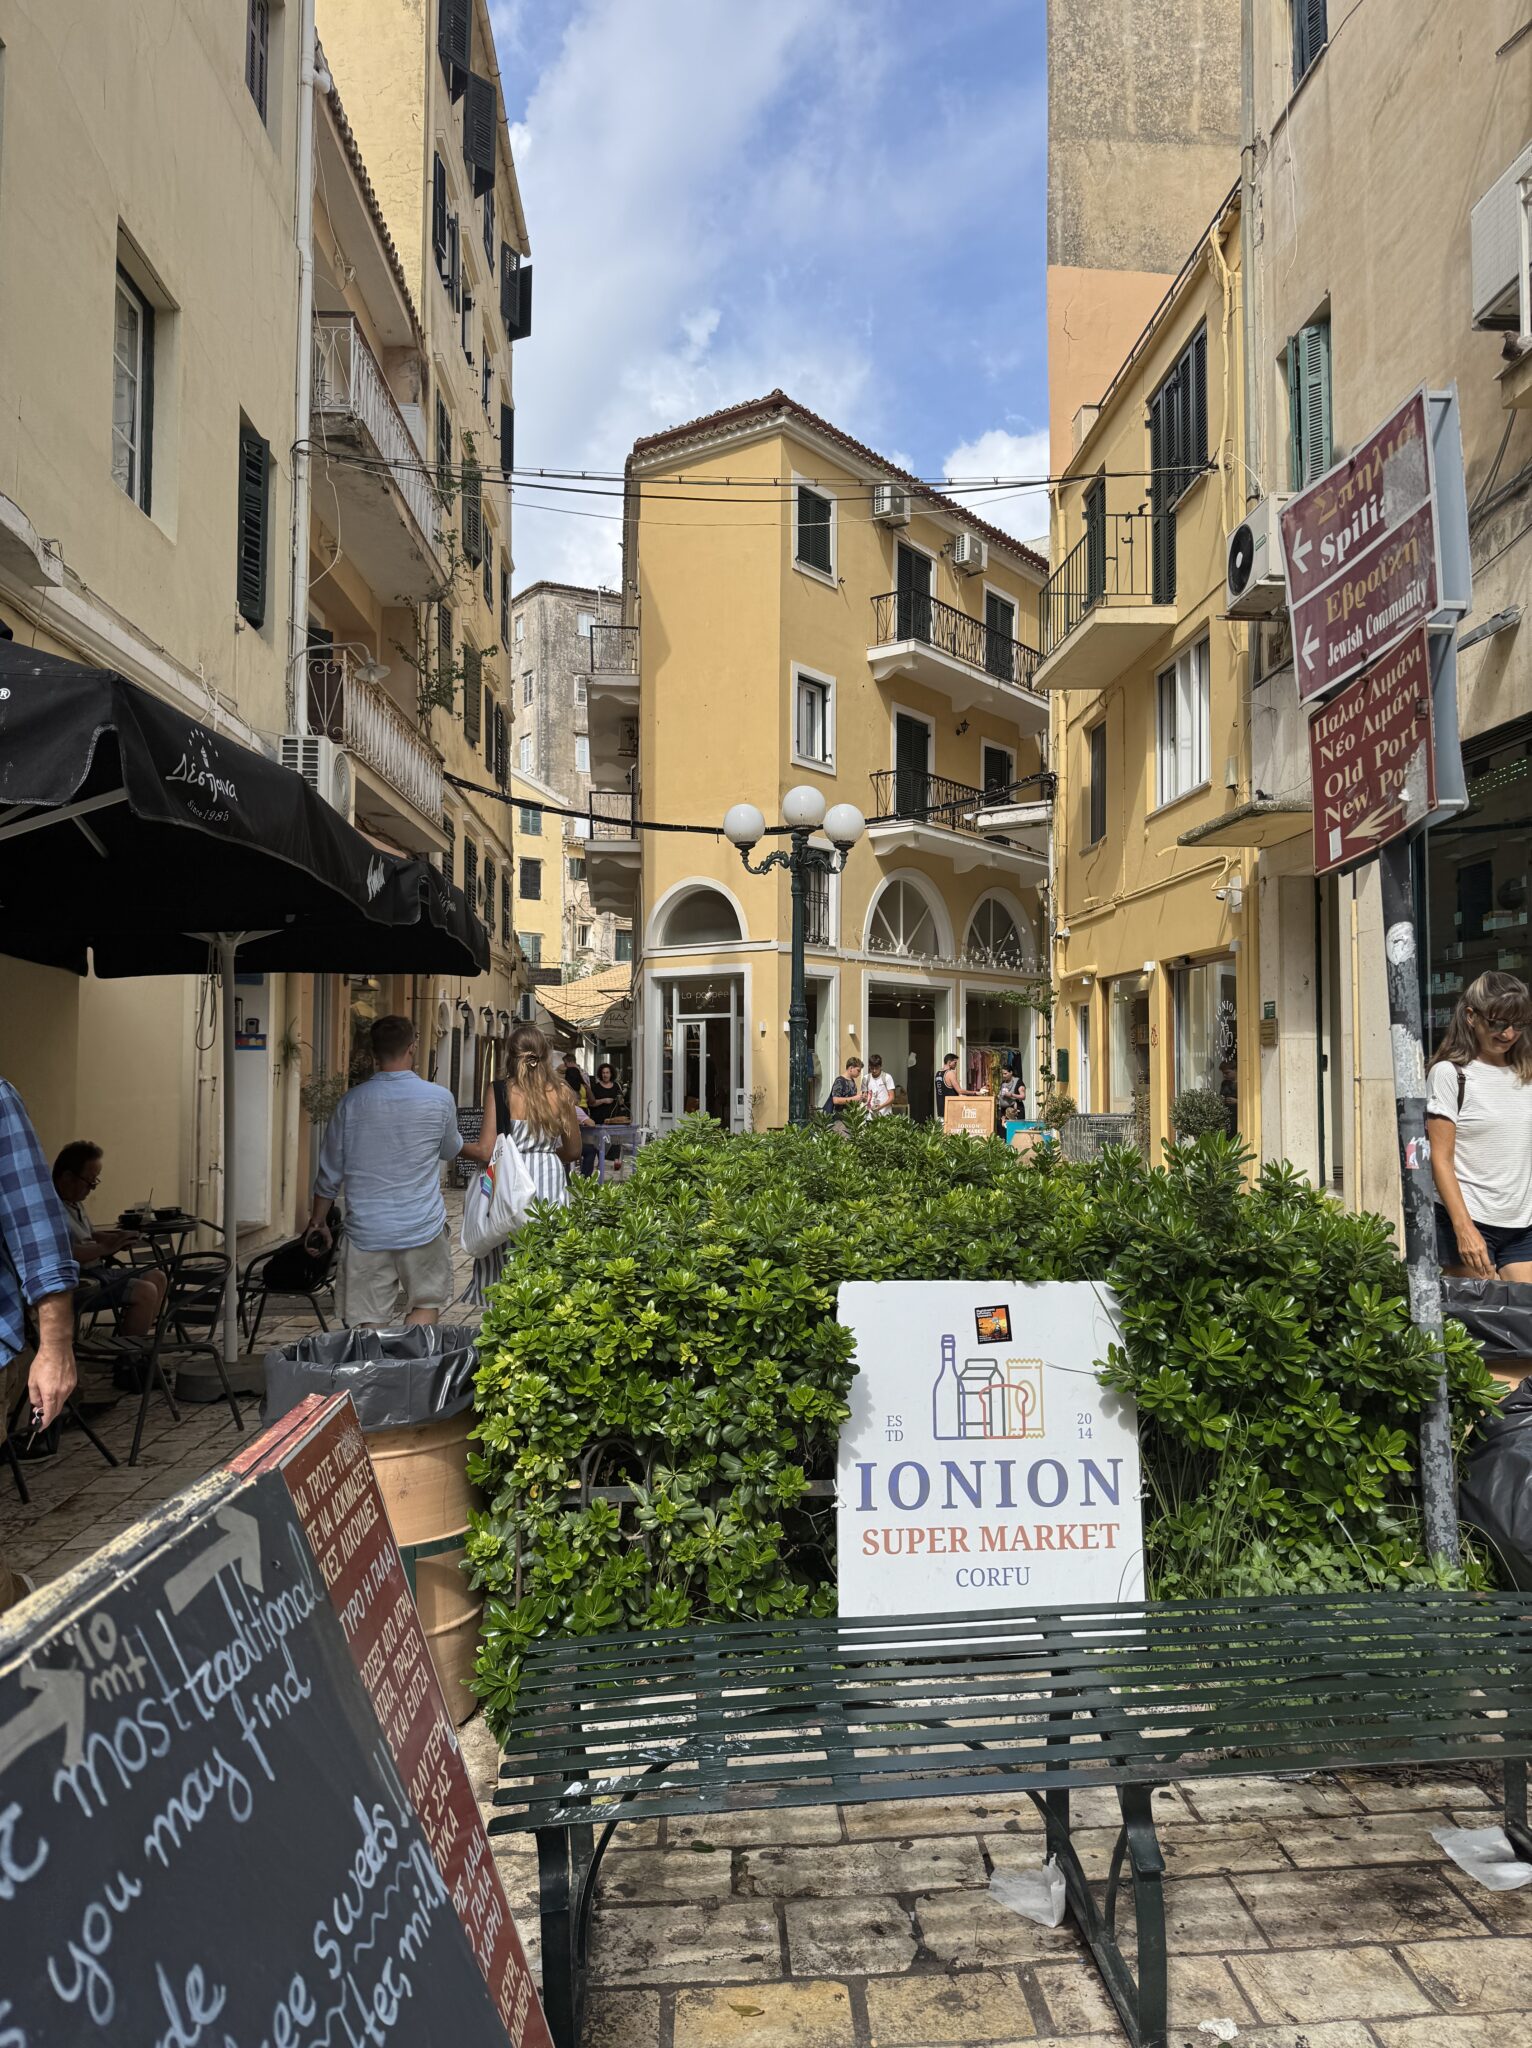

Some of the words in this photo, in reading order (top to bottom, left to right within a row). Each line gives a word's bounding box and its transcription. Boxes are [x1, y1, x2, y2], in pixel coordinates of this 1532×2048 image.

[1328, 624, 1363, 667] Jewish
[1366, 579, 1427, 640] Community
[1314, 690, 1364, 744] Παλιό
[1369, 645, 1422, 705] Λιμάνι
[1320, 733, 1355, 768] Νέο
[1361, 679, 1420, 743] Λιμάνι
[1324, 757, 1364, 798] Old
[1374, 717, 1419, 771] Port
[203, 809, 230, 822] 1985
[1324, 792, 1370, 831] New
[885, 1430, 904, 1442] TD
[886, 1415, 903, 1427] ES
[1076, 1412, 1092, 1425] 20
[1077, 1428, 1093, 1440] 14
[855, 1458, 1124, 1512] IONION
[318, 1506, 335, 1541] ΝΑ
[862, 1526, 971, 1556] SUPER
[979, 1522, 1121, 1552] MARKET
[955, 1566, 1031, 1588] CORFU
[52, 1624, 192, 1818] most
[155, 1520, 326, 1721] traditional
[392, 1703, 410, 1748] ΚΑΙ
[431, 1759, 453, 1818] ΣΑΣ
[47, 1870, 143, 2026] you
[143, 1745, 254, 1868] may
[229, 1636, 312, 1782] find
[471, 1865, 493, 1934] ΓΑΛΑ
